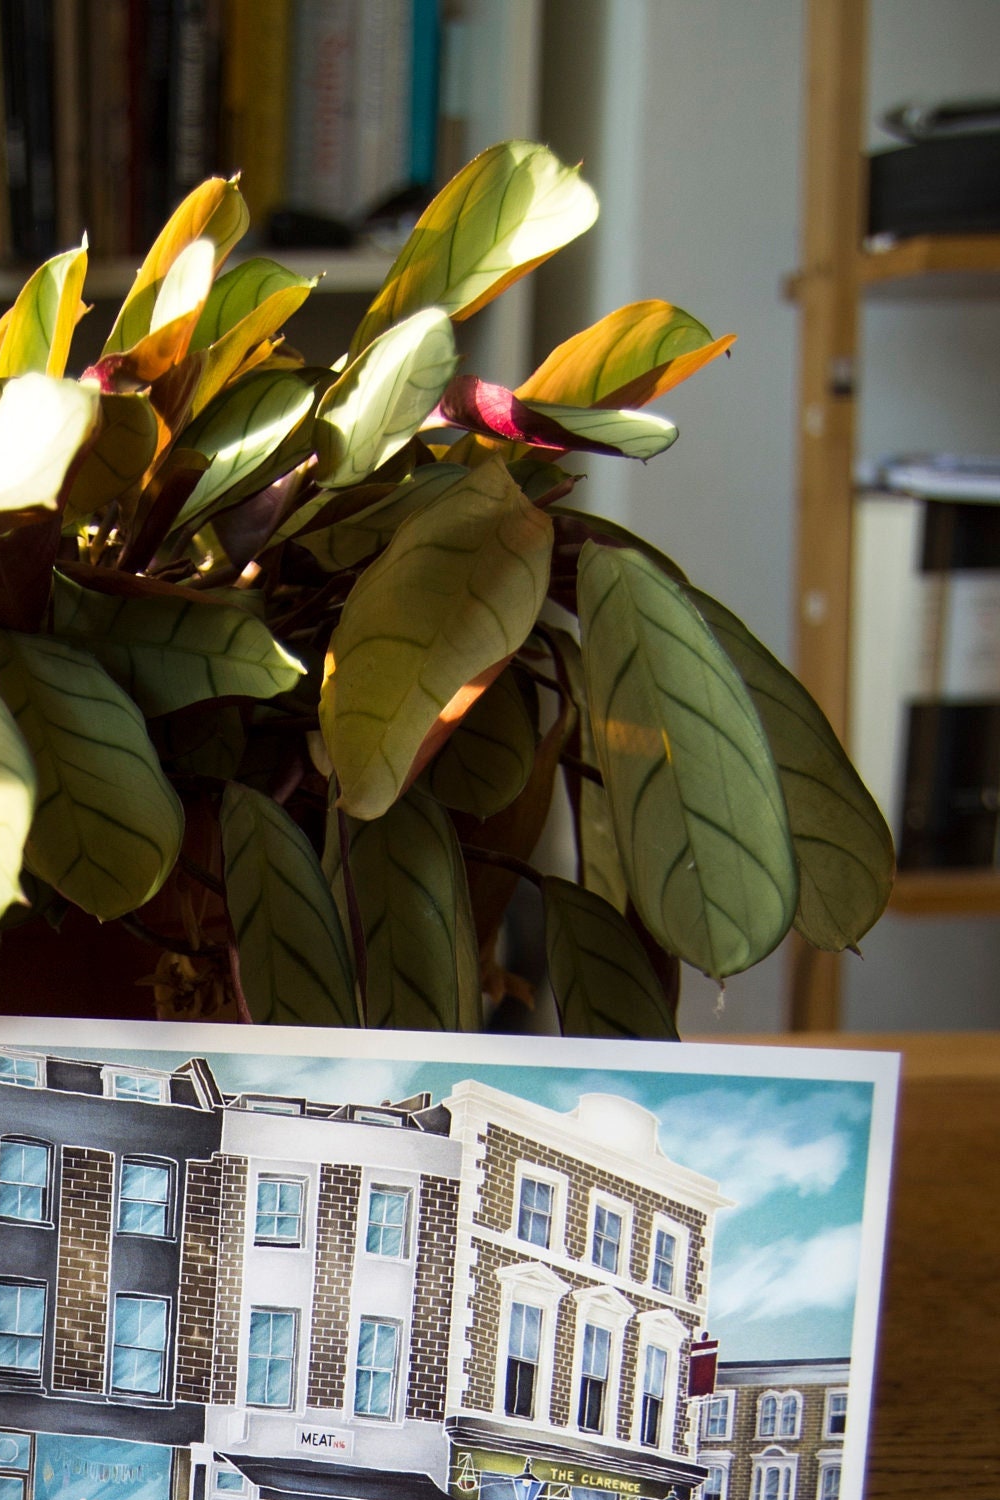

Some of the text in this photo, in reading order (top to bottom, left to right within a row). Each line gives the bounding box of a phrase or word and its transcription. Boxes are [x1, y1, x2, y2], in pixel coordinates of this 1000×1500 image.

[300, 1432, 336, 1447] MEAT
[550, 1467, 641, 1493] THE CLARENCE
